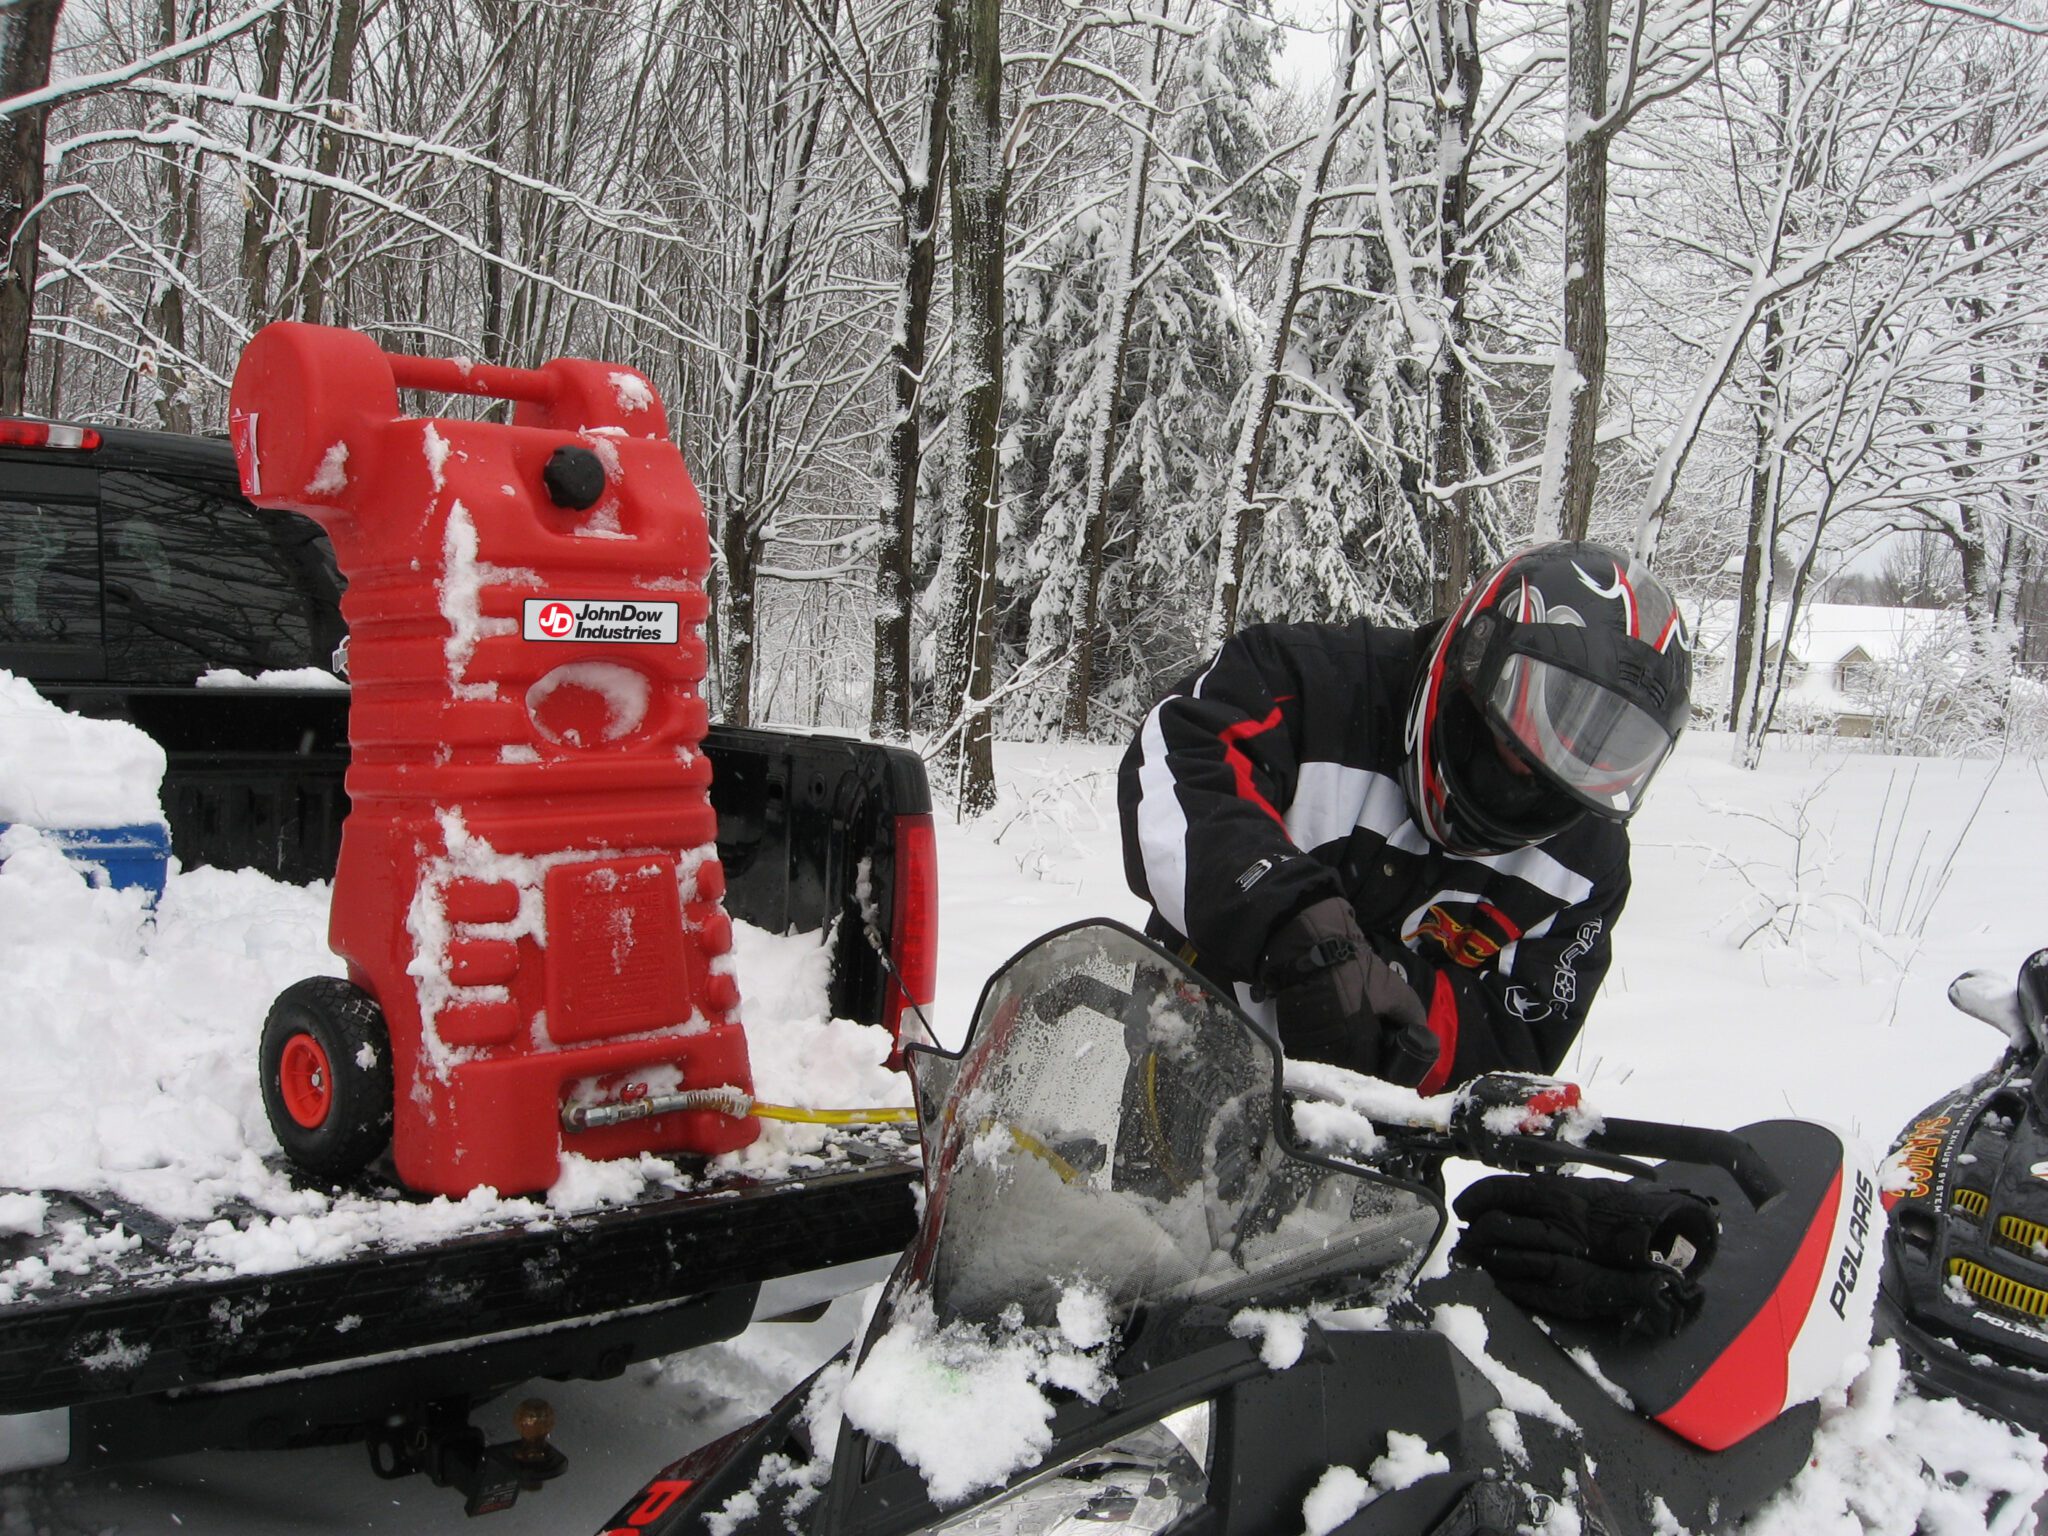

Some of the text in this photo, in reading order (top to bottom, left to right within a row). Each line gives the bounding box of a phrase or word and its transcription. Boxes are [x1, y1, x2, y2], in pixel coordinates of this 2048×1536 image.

[540, 606, 574, 634] JD
[575, 603, 663, 622] JohnDow
[575, 621, 662, 641] Industries
[1940, 1129, 1961, 1169] EXHAUST
[1934, 1172, 1947, 1213] SYSTEM
[1829, 1168, 1874, 1322] POLARIS
